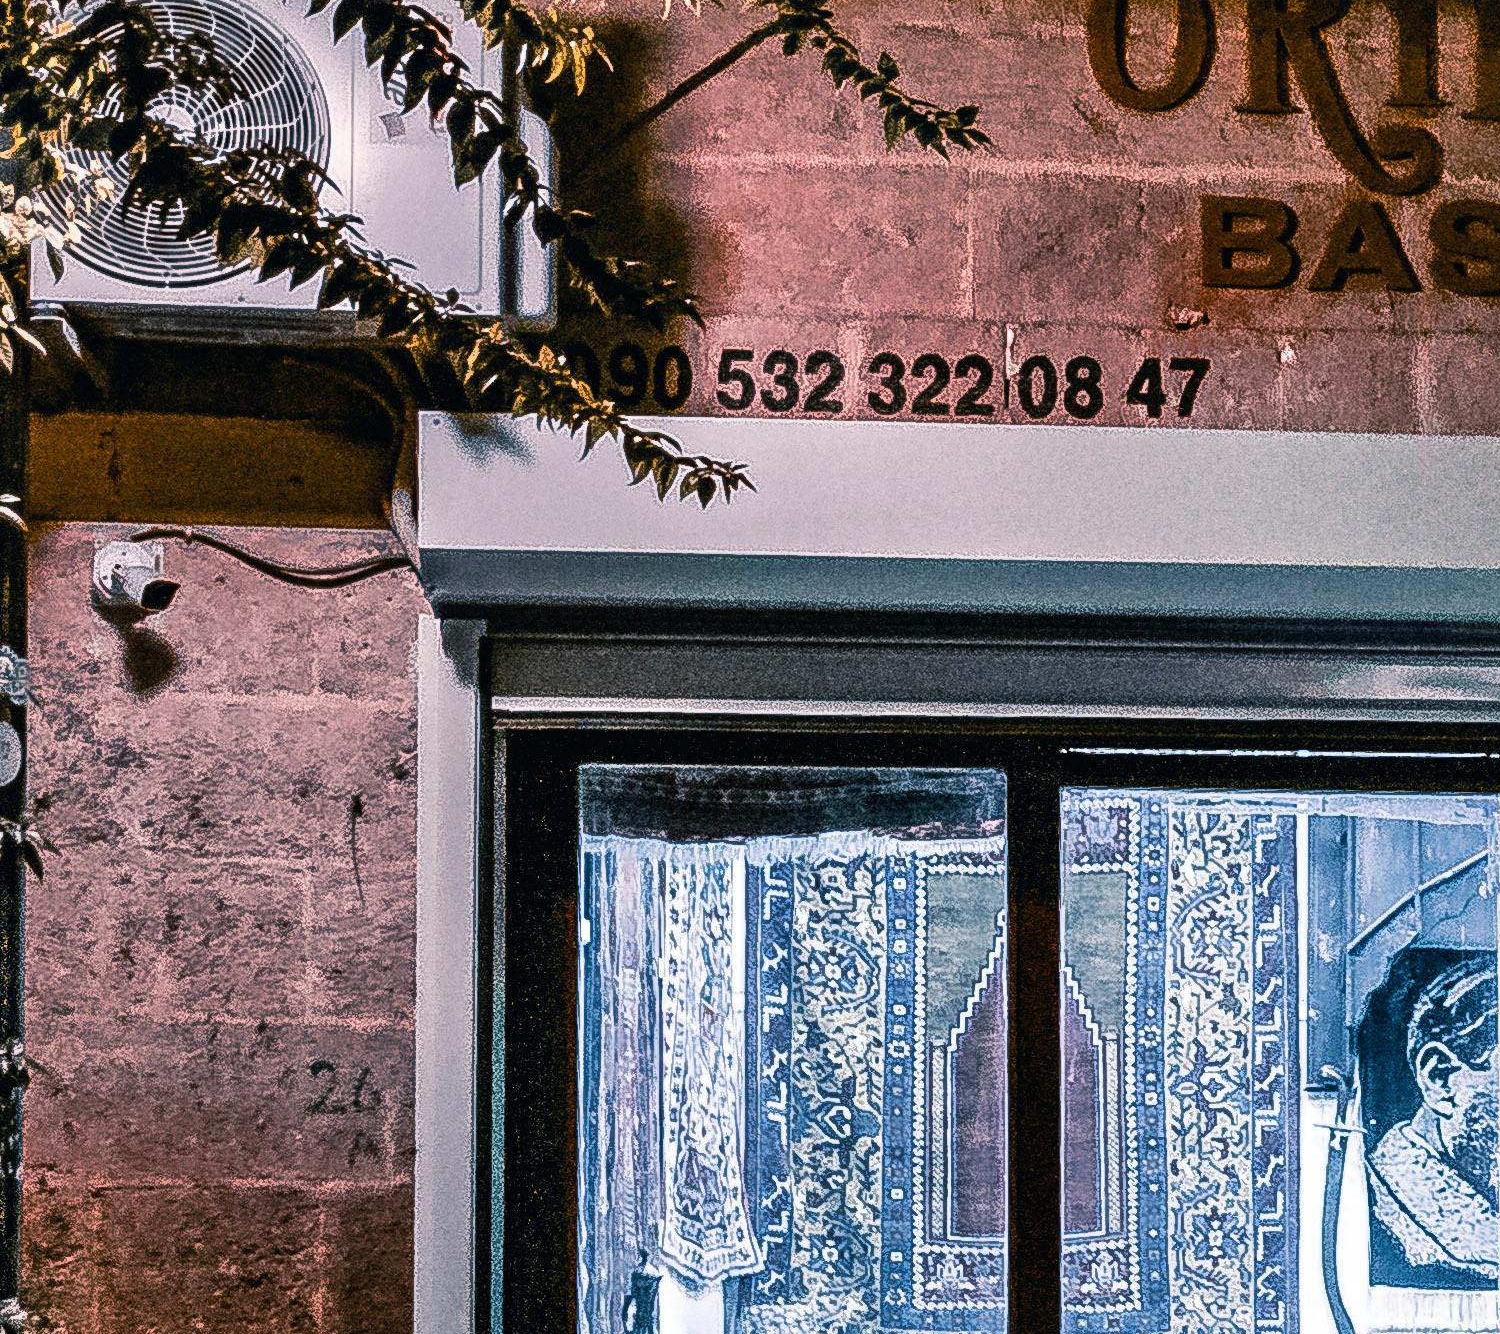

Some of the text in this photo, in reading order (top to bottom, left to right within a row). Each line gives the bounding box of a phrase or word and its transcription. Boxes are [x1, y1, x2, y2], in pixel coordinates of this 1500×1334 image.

[717, 348, 843, 414] 532
[868, 352, 997, 416] 322
[1018, 355, 1104, 419] 08
[1126, 357, 1211, 419] 47
